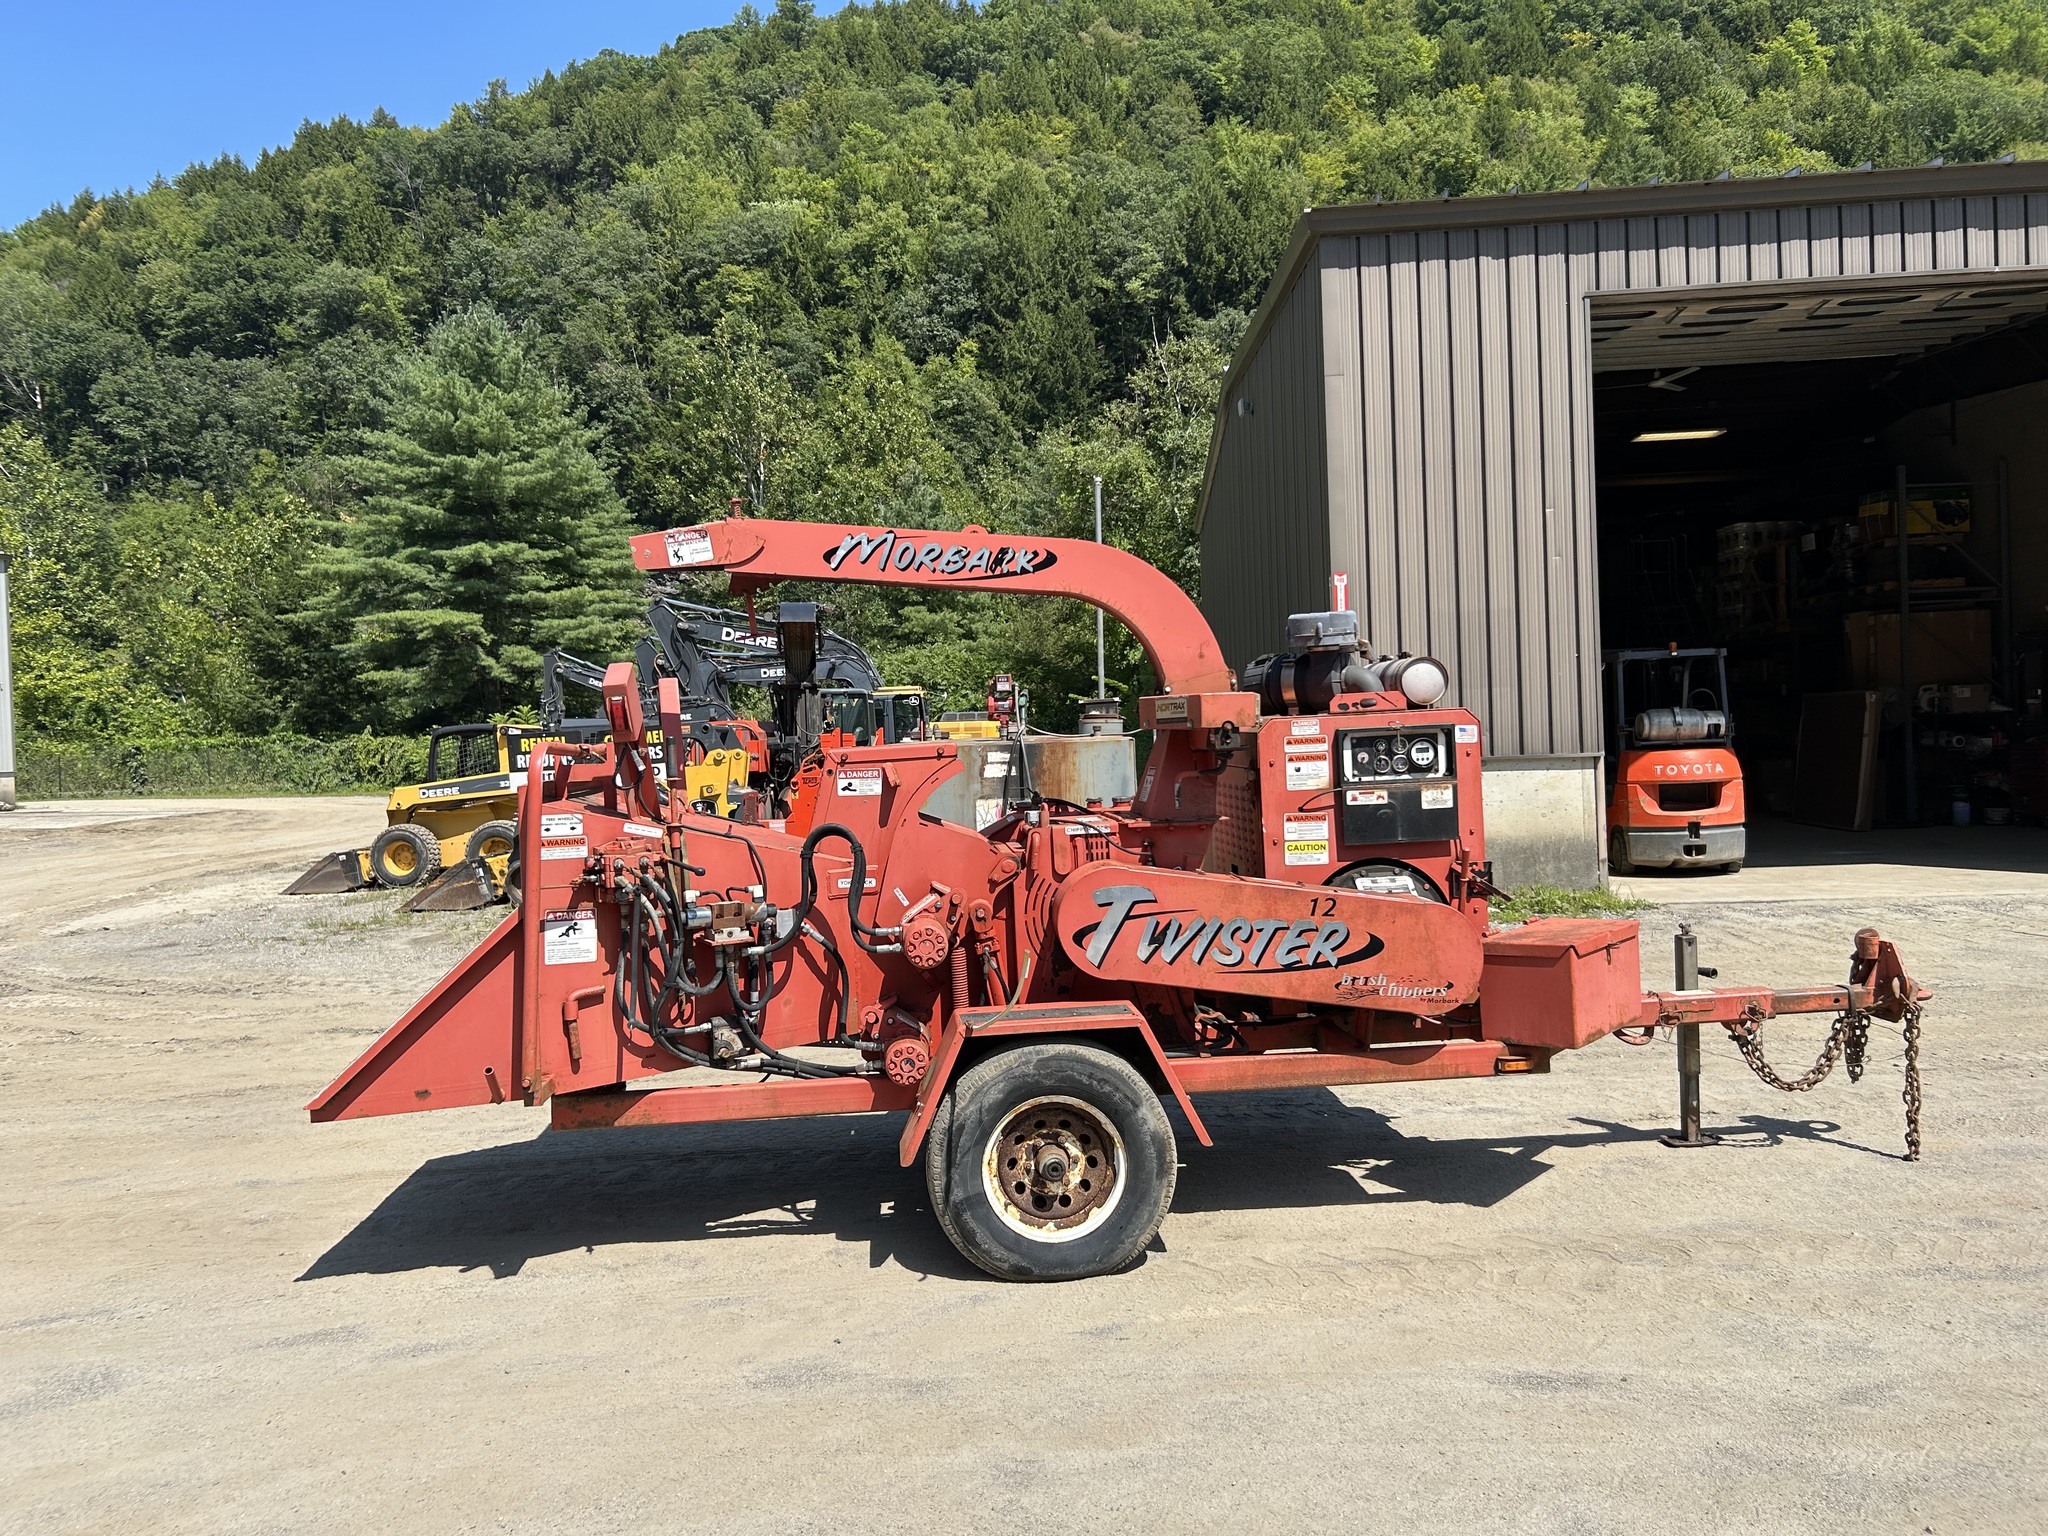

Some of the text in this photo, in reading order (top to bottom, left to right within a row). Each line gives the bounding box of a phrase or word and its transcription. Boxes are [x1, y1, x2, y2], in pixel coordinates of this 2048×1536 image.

[829, 529, 1038, 574] MORBARK
[721, 627, 779, 650] DEERE
[760, 668, 787, 678] DEE
[1156, 701, 1186, 713] NORTRAX
[1293, 737, 1327, 746] WARNING
[1294, 754, 1328, 762] WARNING
[846, 770, 880, 779] DANGER
[1654, 762, 1725, 776] TOYOTA
[419, 786, 460, 799] DEERE
[1066, 825, 1091, 833] CHIPPR
[546, 837, 586, 847] WARNING
[1286, 843, 1327, 852] CAUTION
[1309, 896, 1338, 918] 12
[555, 910, 595, 920] DANGER
[1085, 885, 1352, 970] TWISTER
[1340, 972, 1388, 987] brush
[1378, 982, 1449, 999] chippers
